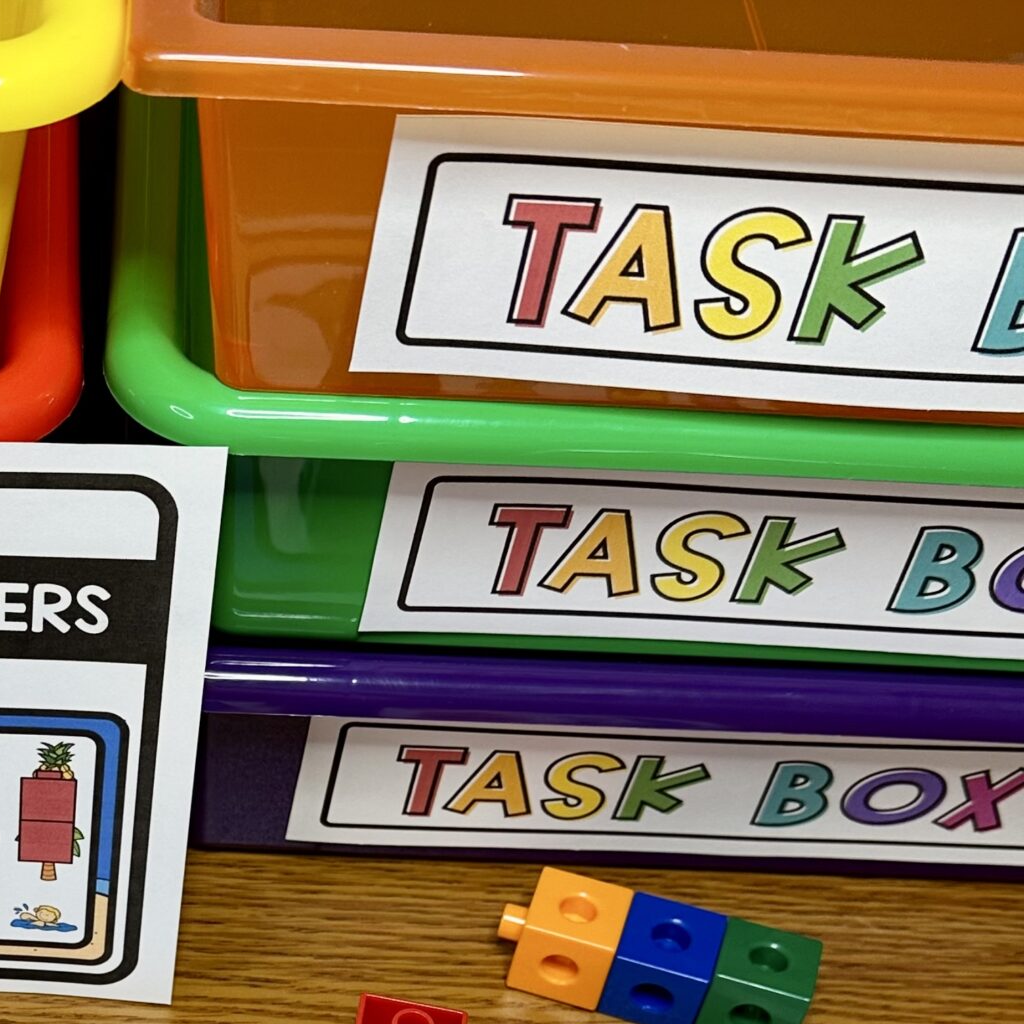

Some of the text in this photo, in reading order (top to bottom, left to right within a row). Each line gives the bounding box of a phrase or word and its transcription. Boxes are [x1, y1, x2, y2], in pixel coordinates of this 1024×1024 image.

[503, 194, 924, 344] TASK
[488, 504, 846, 603] TASK
[397, 745, 1024, 832] TASK BOX
